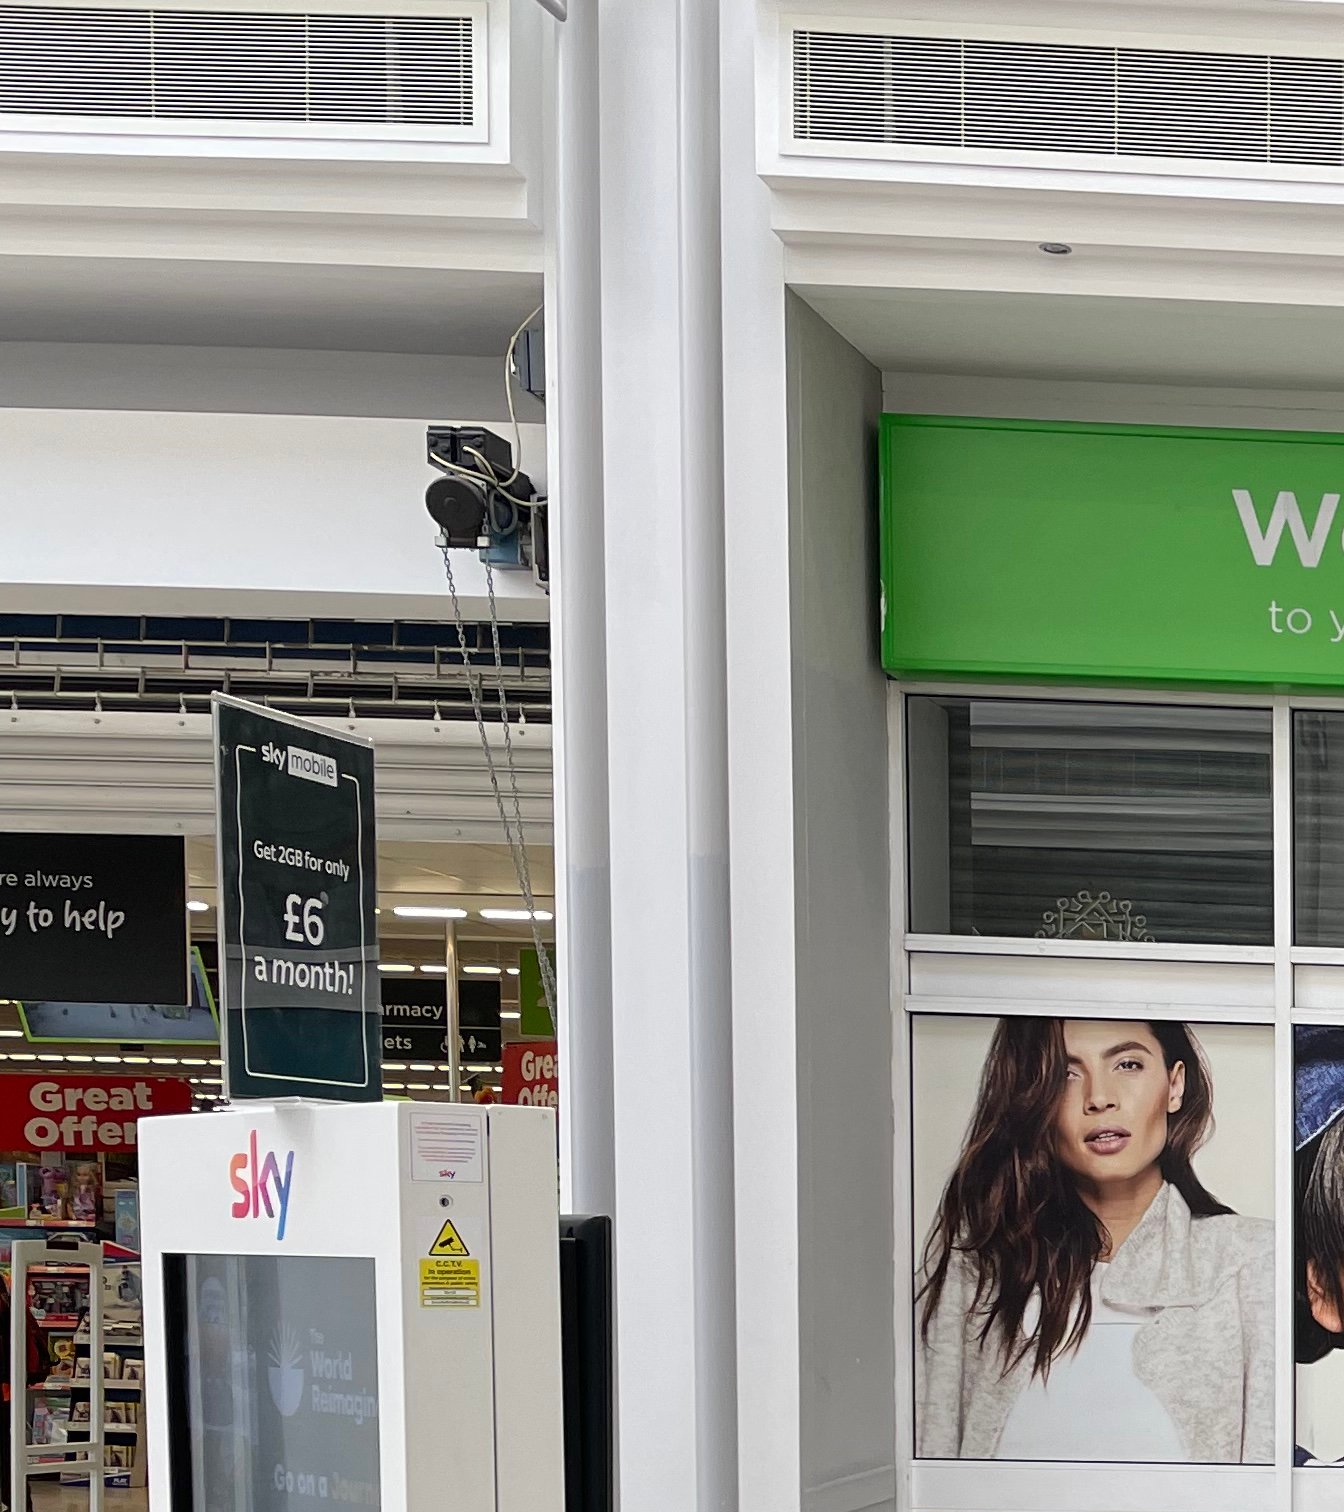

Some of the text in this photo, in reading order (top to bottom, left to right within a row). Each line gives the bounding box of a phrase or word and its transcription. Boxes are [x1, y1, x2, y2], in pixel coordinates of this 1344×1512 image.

[1268, 600, 1312, 635] to
[261, 742, 335, 780] sky mobile
[253, 840, 350, 882] Get 2GB for only
[24, 870, 94, 891] always
[26, 901, 53, 932] to
[64, 900, 125, 939] help
[284, 894, 324, 946] £6
[254, 955, 354, 995] a month!
[29, 1081, 153, 1112] Great
[229, 1130, 294, 1241] sky
[310, 1352, 352, 1381] World
